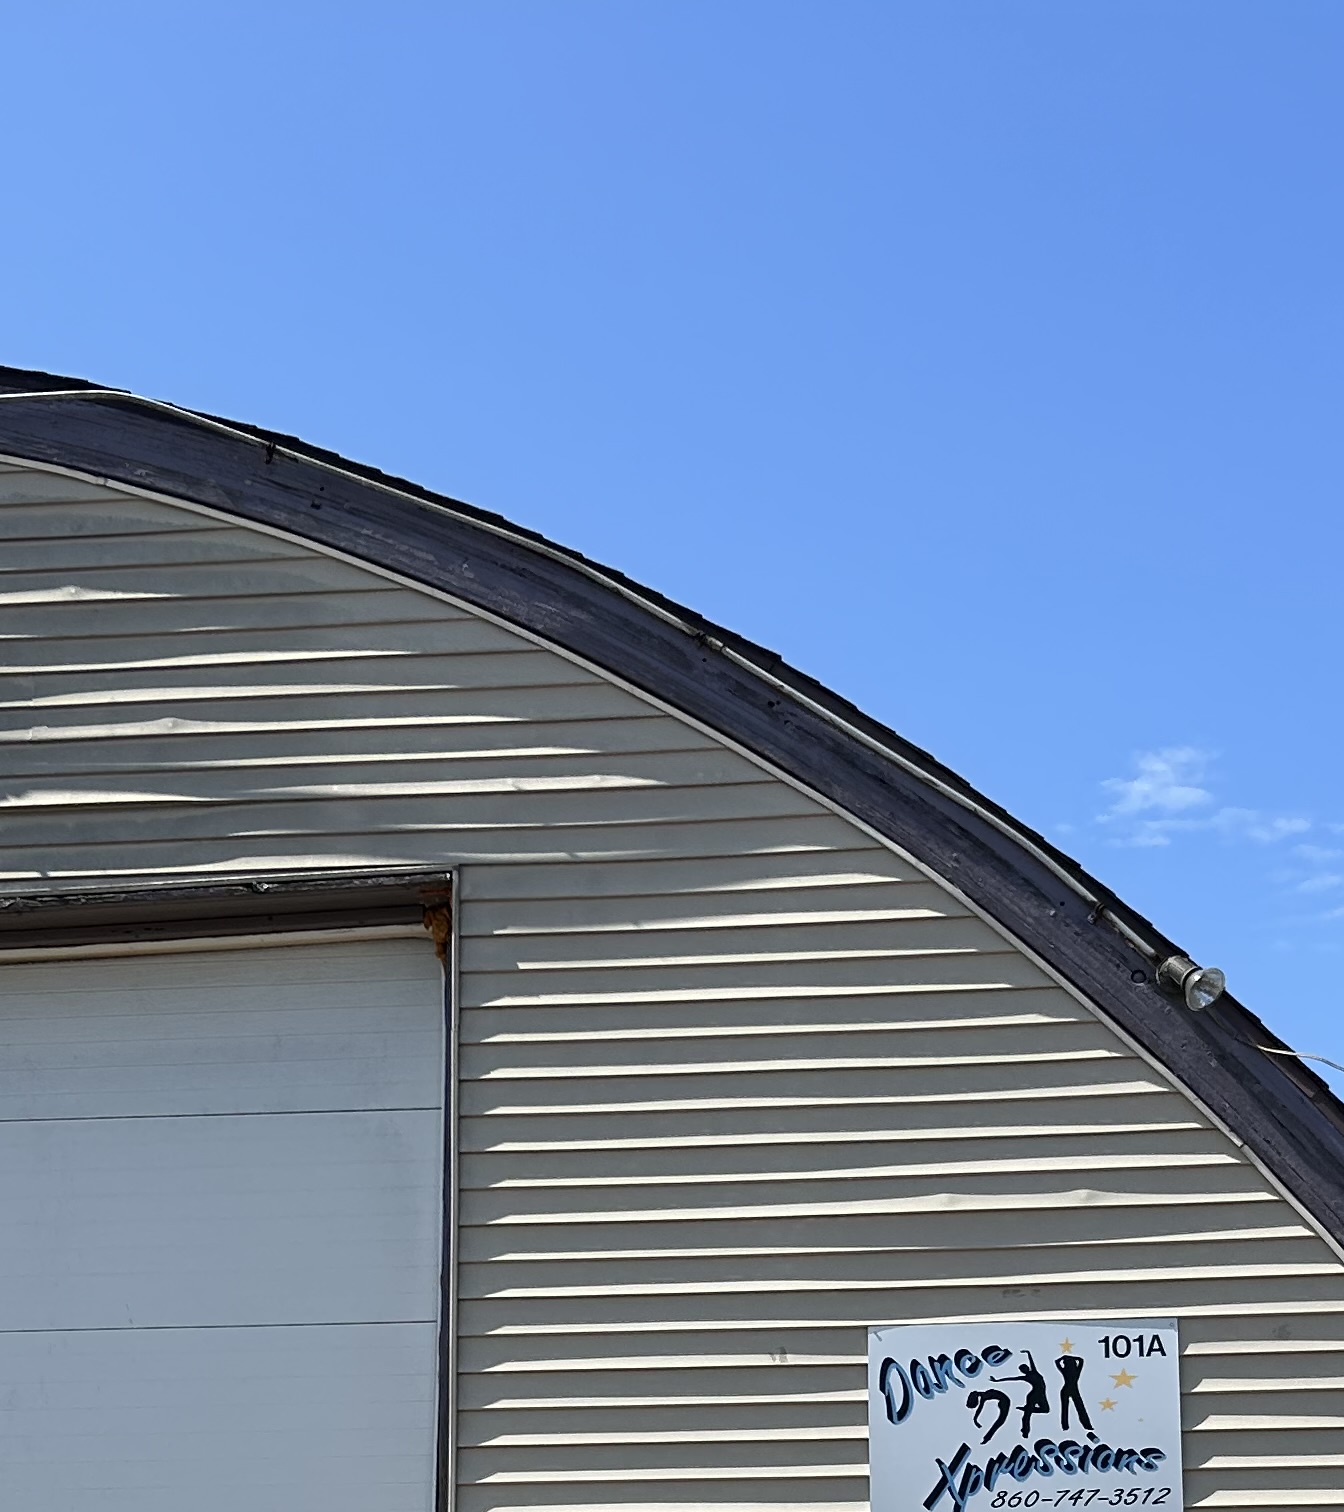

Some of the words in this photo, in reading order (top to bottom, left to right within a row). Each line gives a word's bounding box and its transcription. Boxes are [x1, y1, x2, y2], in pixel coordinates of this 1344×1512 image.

[1098, 1334, 1167, 1359] 101A
[879, 1345, 1013, 1425] Dance
[990, 1487, 1172, 1509] 860-747-3512
